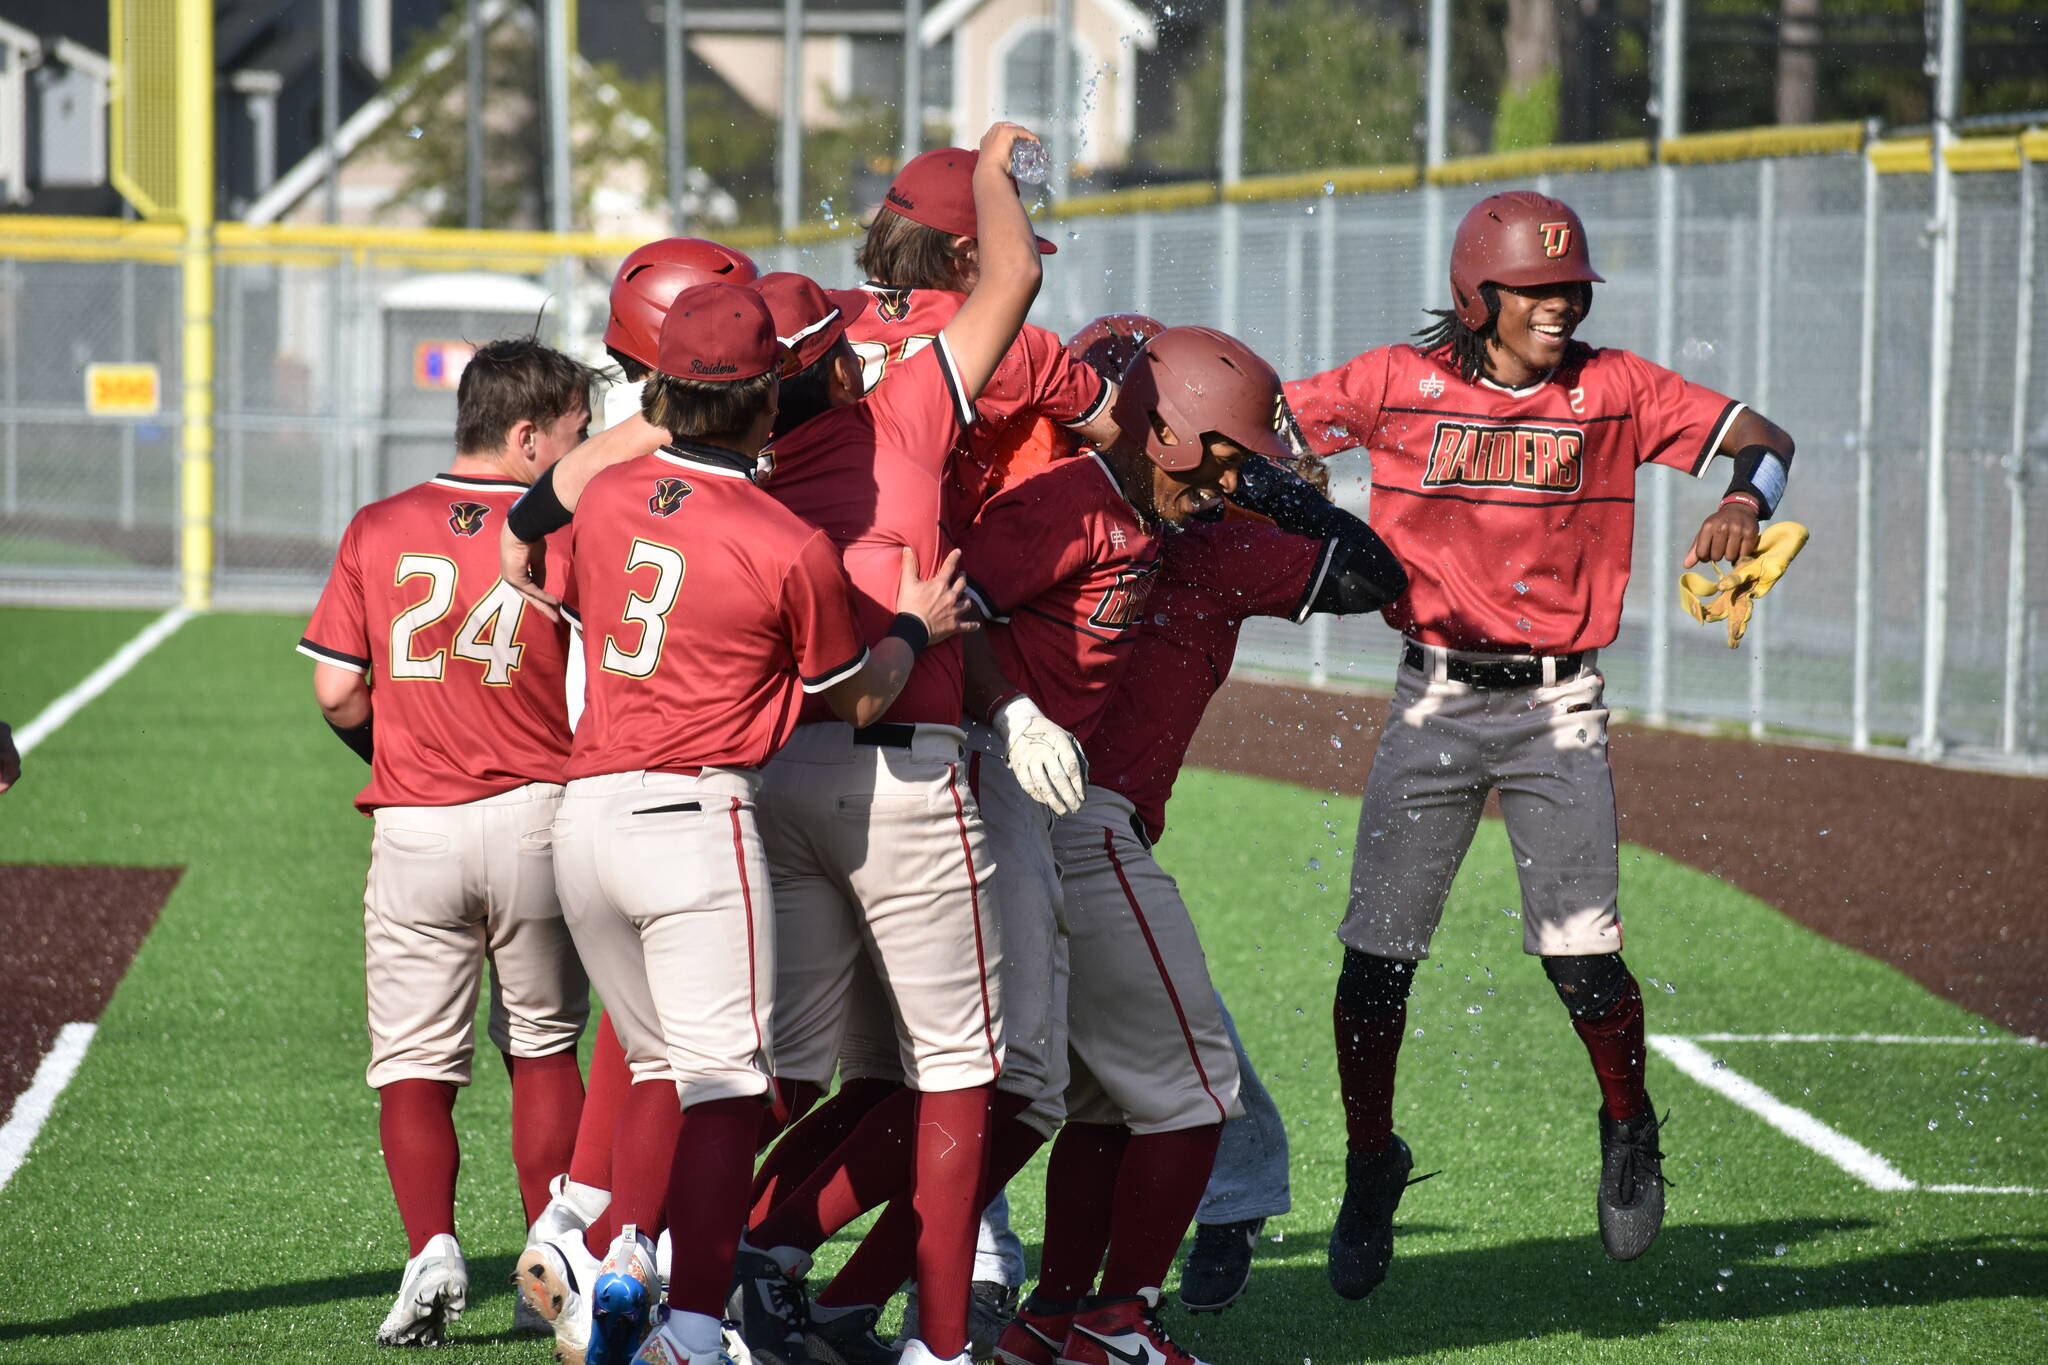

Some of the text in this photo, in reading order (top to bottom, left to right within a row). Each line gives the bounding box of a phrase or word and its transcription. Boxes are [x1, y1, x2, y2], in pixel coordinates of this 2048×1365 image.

[1537, 220, 1571, 259] TJ
[688, 358, 738, 375] Raiders
[1424, 422, 1583, 492] RAIDERS
[389, 552, 526, 686] 24
[600, 537, 686, 680] 3
